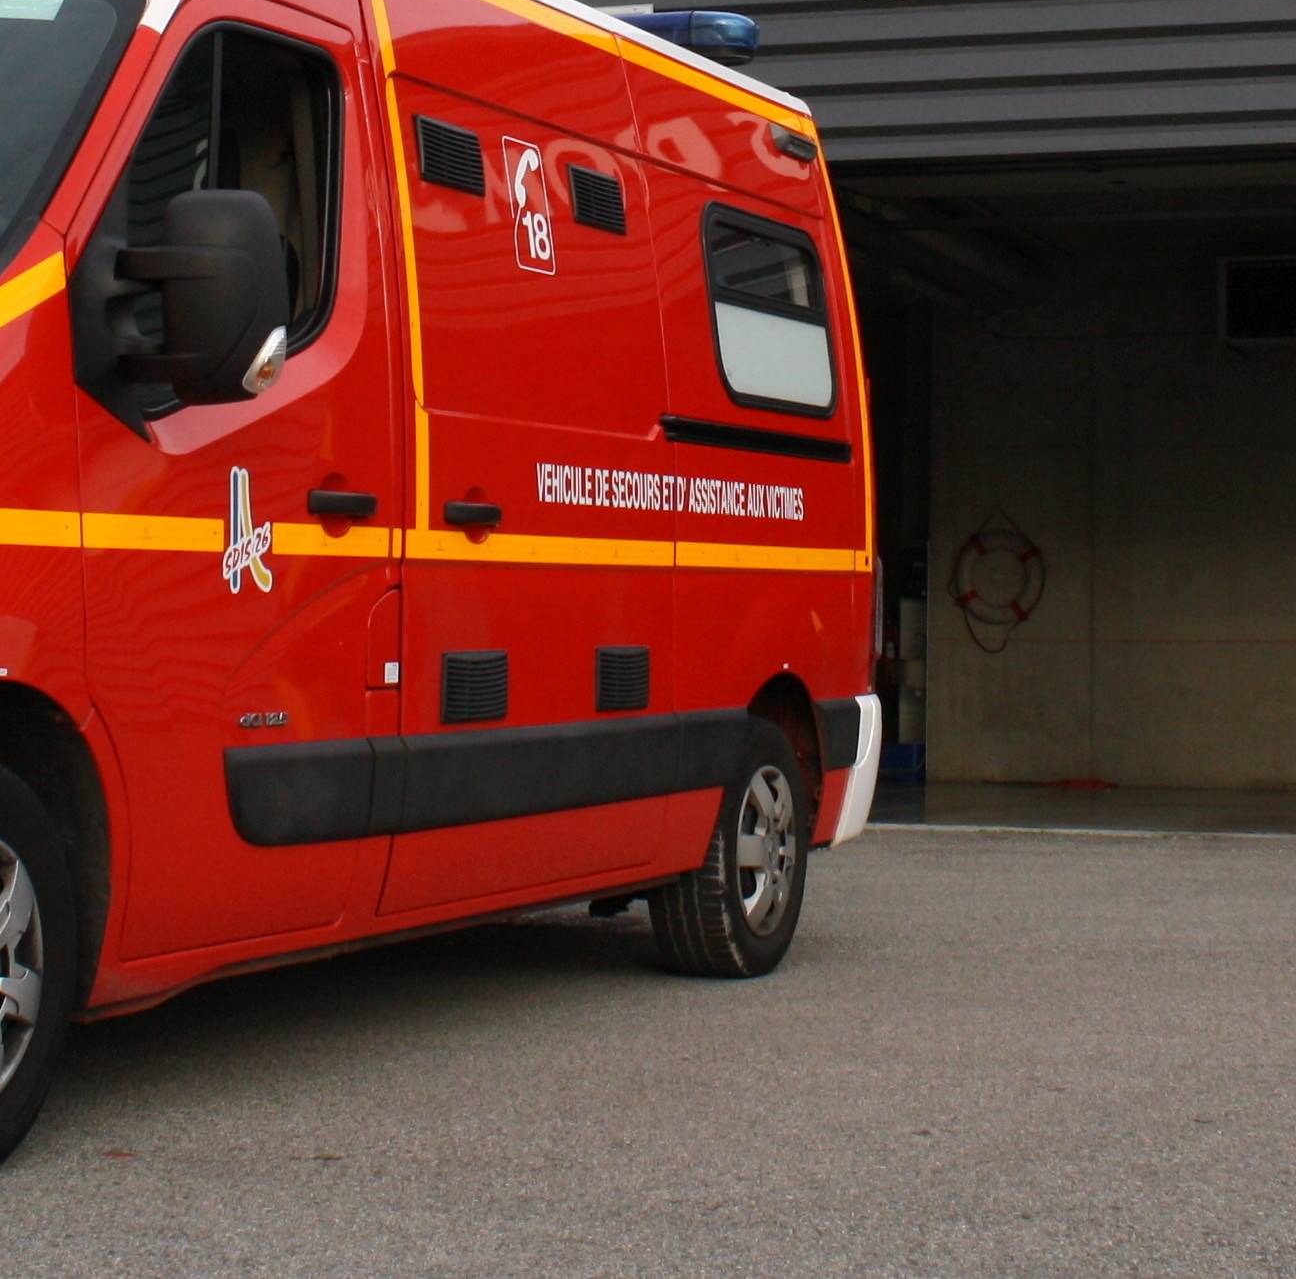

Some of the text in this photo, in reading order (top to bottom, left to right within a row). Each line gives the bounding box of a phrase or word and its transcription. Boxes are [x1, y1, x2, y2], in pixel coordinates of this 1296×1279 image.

[522, 211, 551, 260] 18
[536, 462, 804, 521] VEHICULE DE SECOURS ET D' ASSISTANCE AUX VICTIMES
[225, 525, 269, 575] SDIS 26
